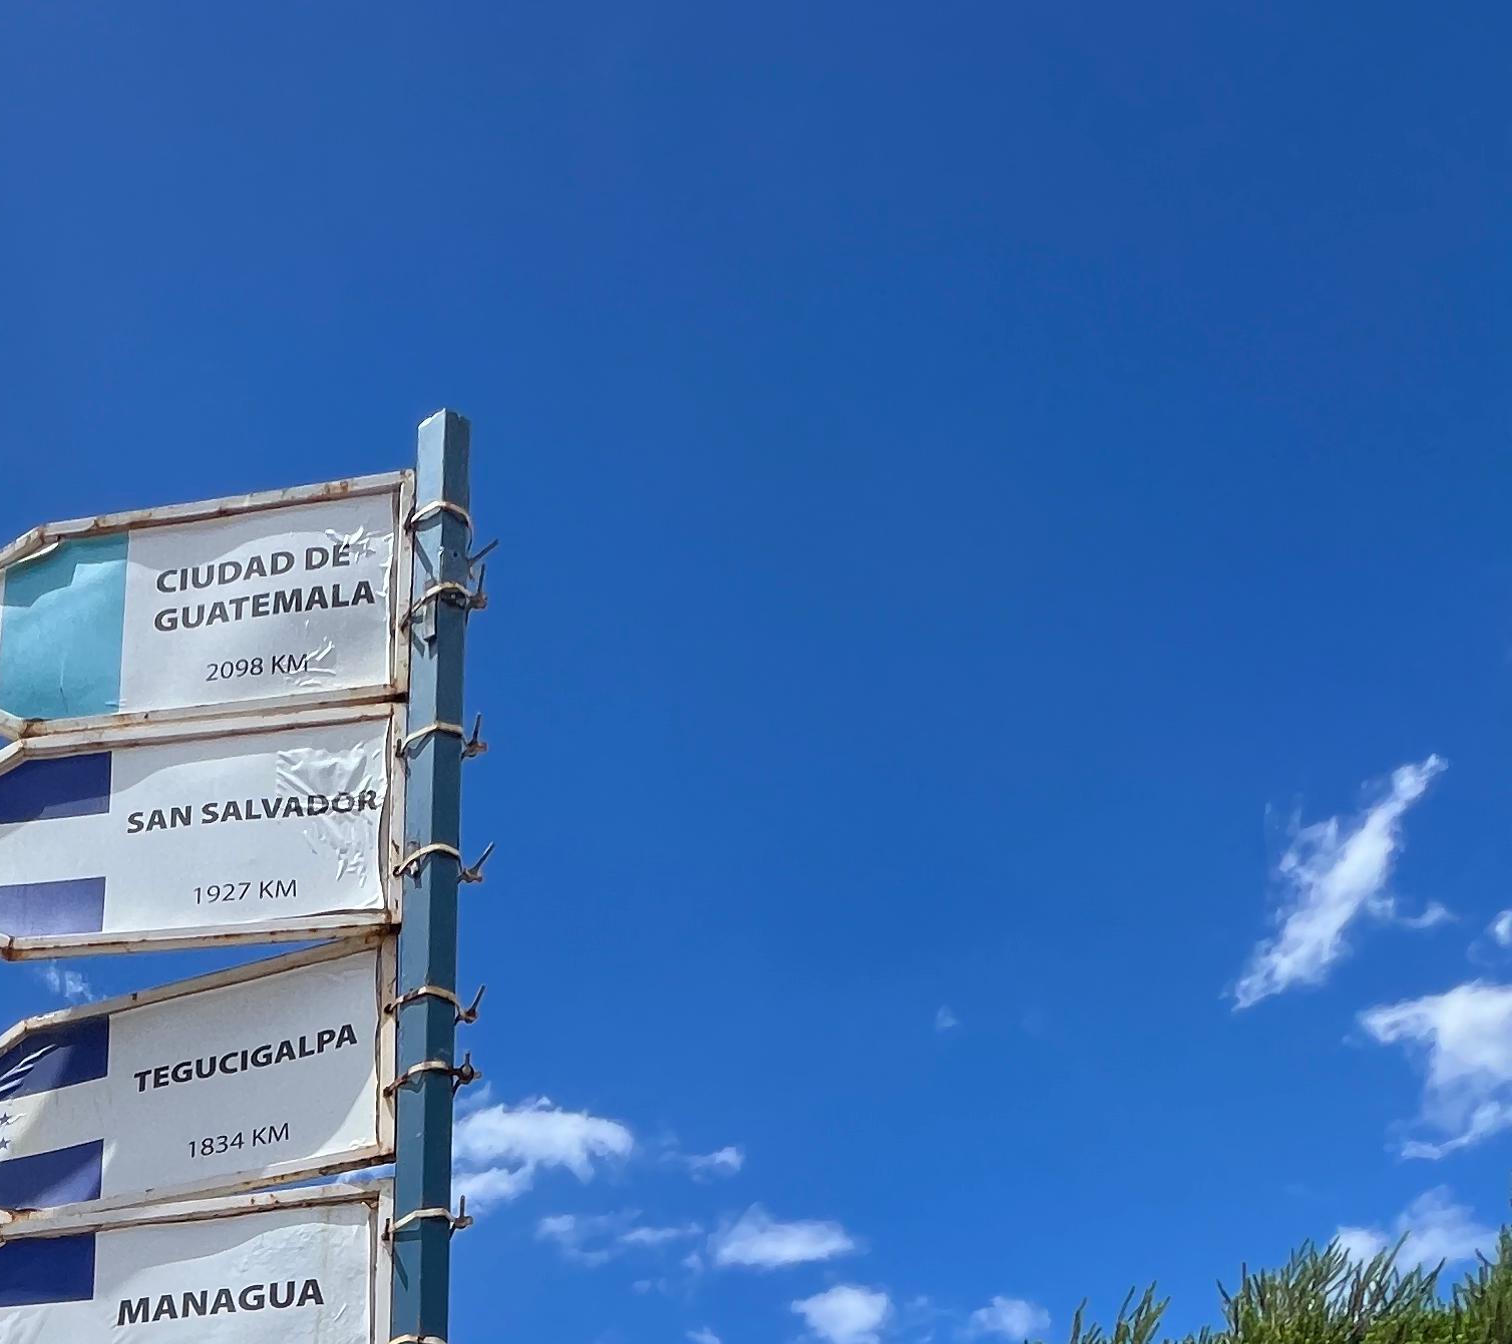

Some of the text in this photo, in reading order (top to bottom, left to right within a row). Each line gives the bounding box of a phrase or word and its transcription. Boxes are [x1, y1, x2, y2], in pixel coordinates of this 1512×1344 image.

[155, 544, 350, 593] CIUDAD DE
[154, 580, 375, 632] GUATEMALA
[206, 653, 309, 682] 2098 KM
[127, 789, 378, 834] SAN SALVADOR
[194, 879, 298, 905] 1927 KM
[134, 1023, 358, 1093] TEGUCIGALPA
[188, 1123, 290, 1158] 1834 KM
[117, 1278, 325, 1326] MANAGUA
